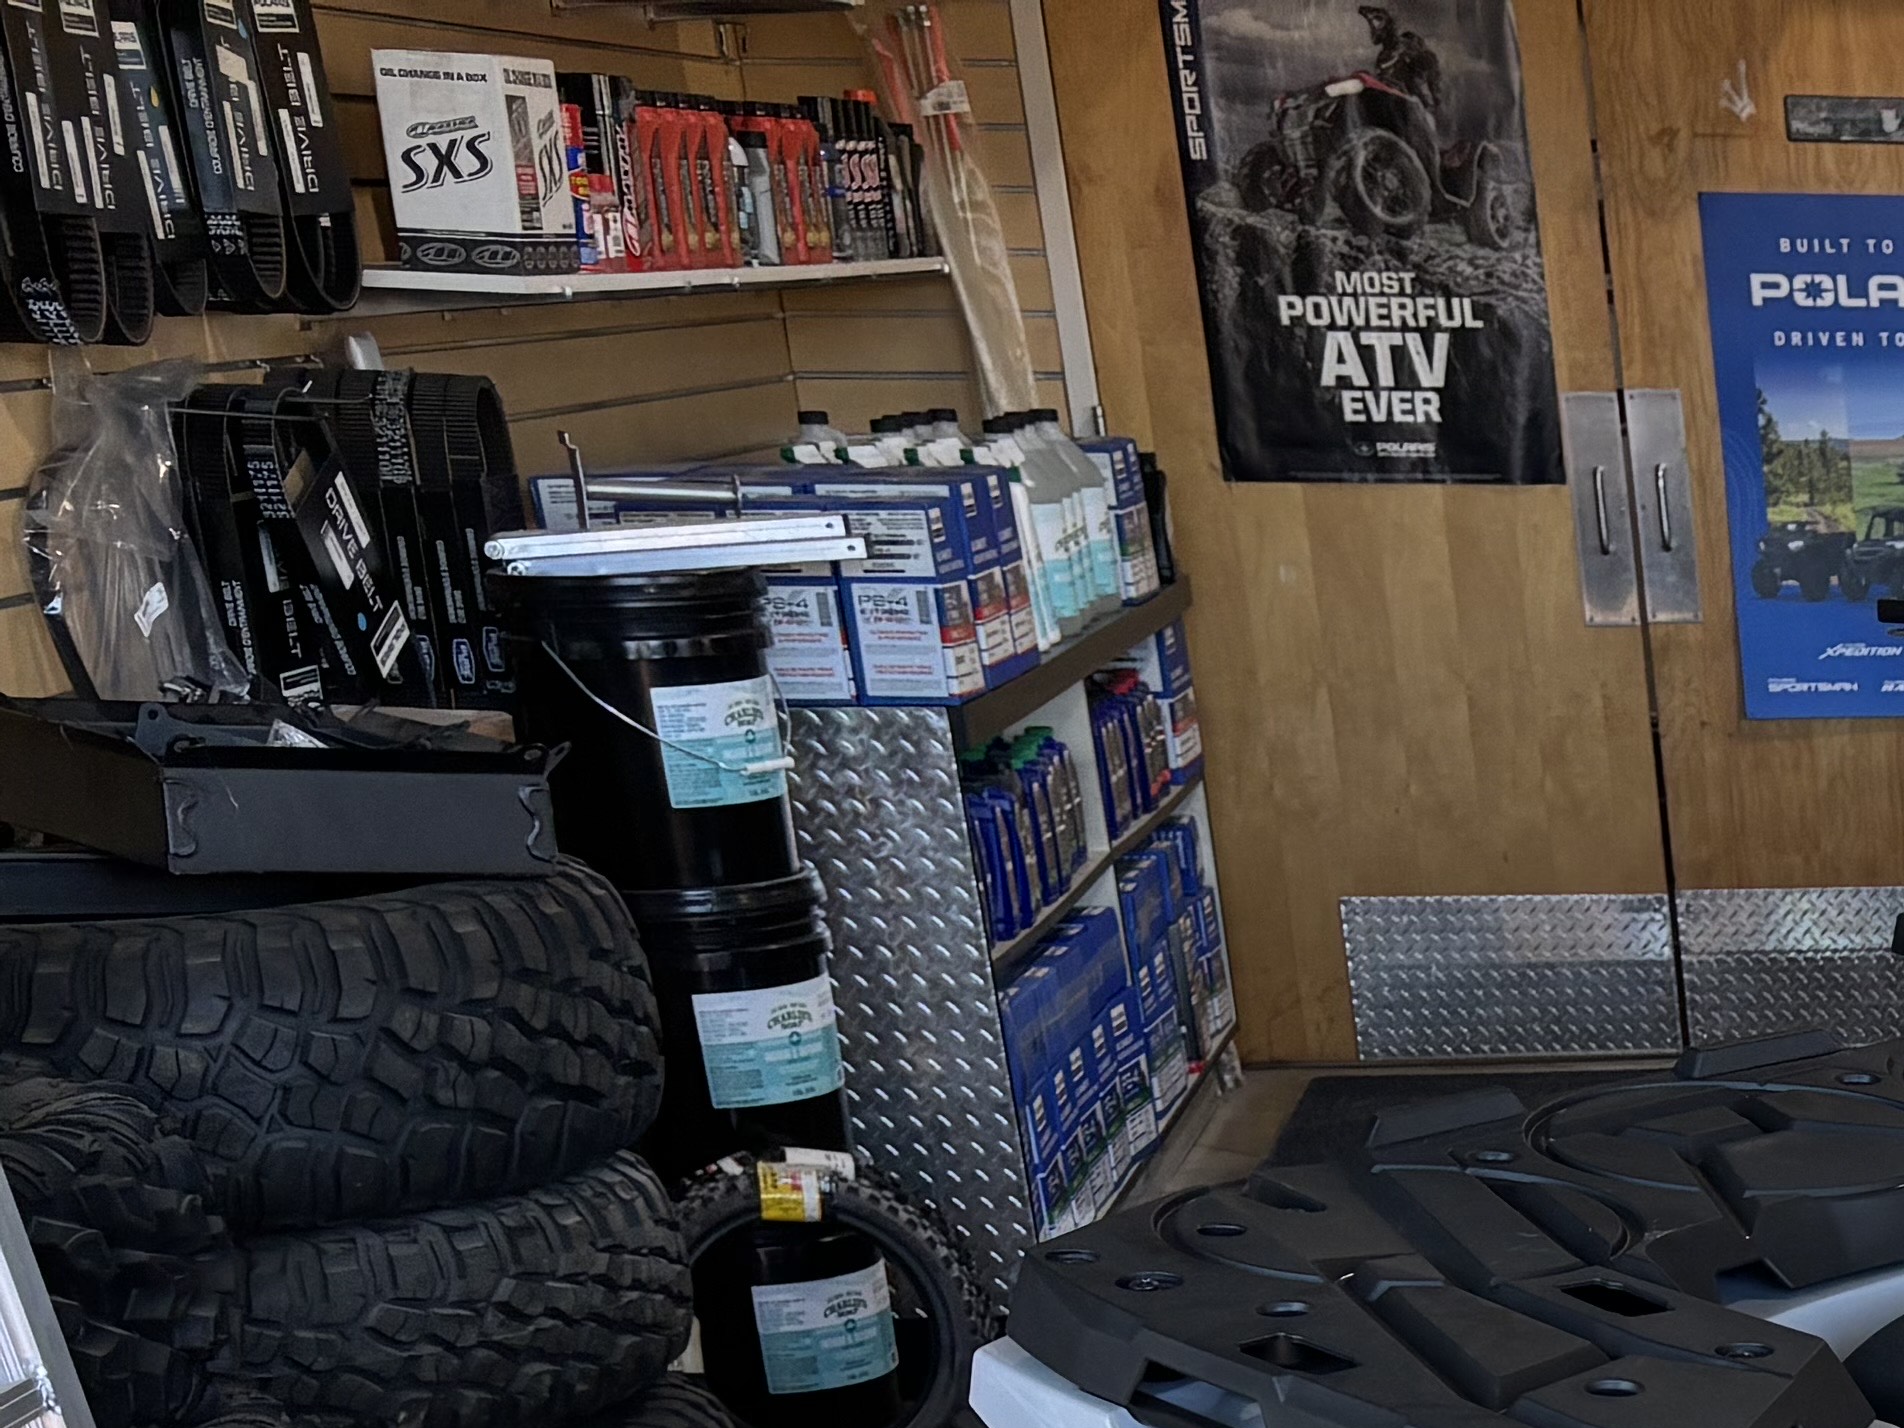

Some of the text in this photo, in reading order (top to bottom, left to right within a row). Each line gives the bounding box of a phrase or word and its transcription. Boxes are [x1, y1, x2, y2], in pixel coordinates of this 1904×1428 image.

[80, 44, 116, 211] DRIVE BELT
[277, 43, 320, 194] DRIVE BELT
[129, 80, 176, 240] DRIVE BELT
[232, 110, 256, 192] DRIVE
[400, 130, 495, 194] SXS
[1779, 237, 1851, 254] BUILT
[1866, 239, 1894, 255] TO
[1278, 294, 1484, 329] POWERFUL
[1334, 271, 1416, 295] MOST
[1320, 330, 1451, 389] ATV
[1773, 330, 1865, 348] DRIVEN
[1341, 389, 1443, 424] EVER
[324, 486, 384, 613] DRIVE BELT
